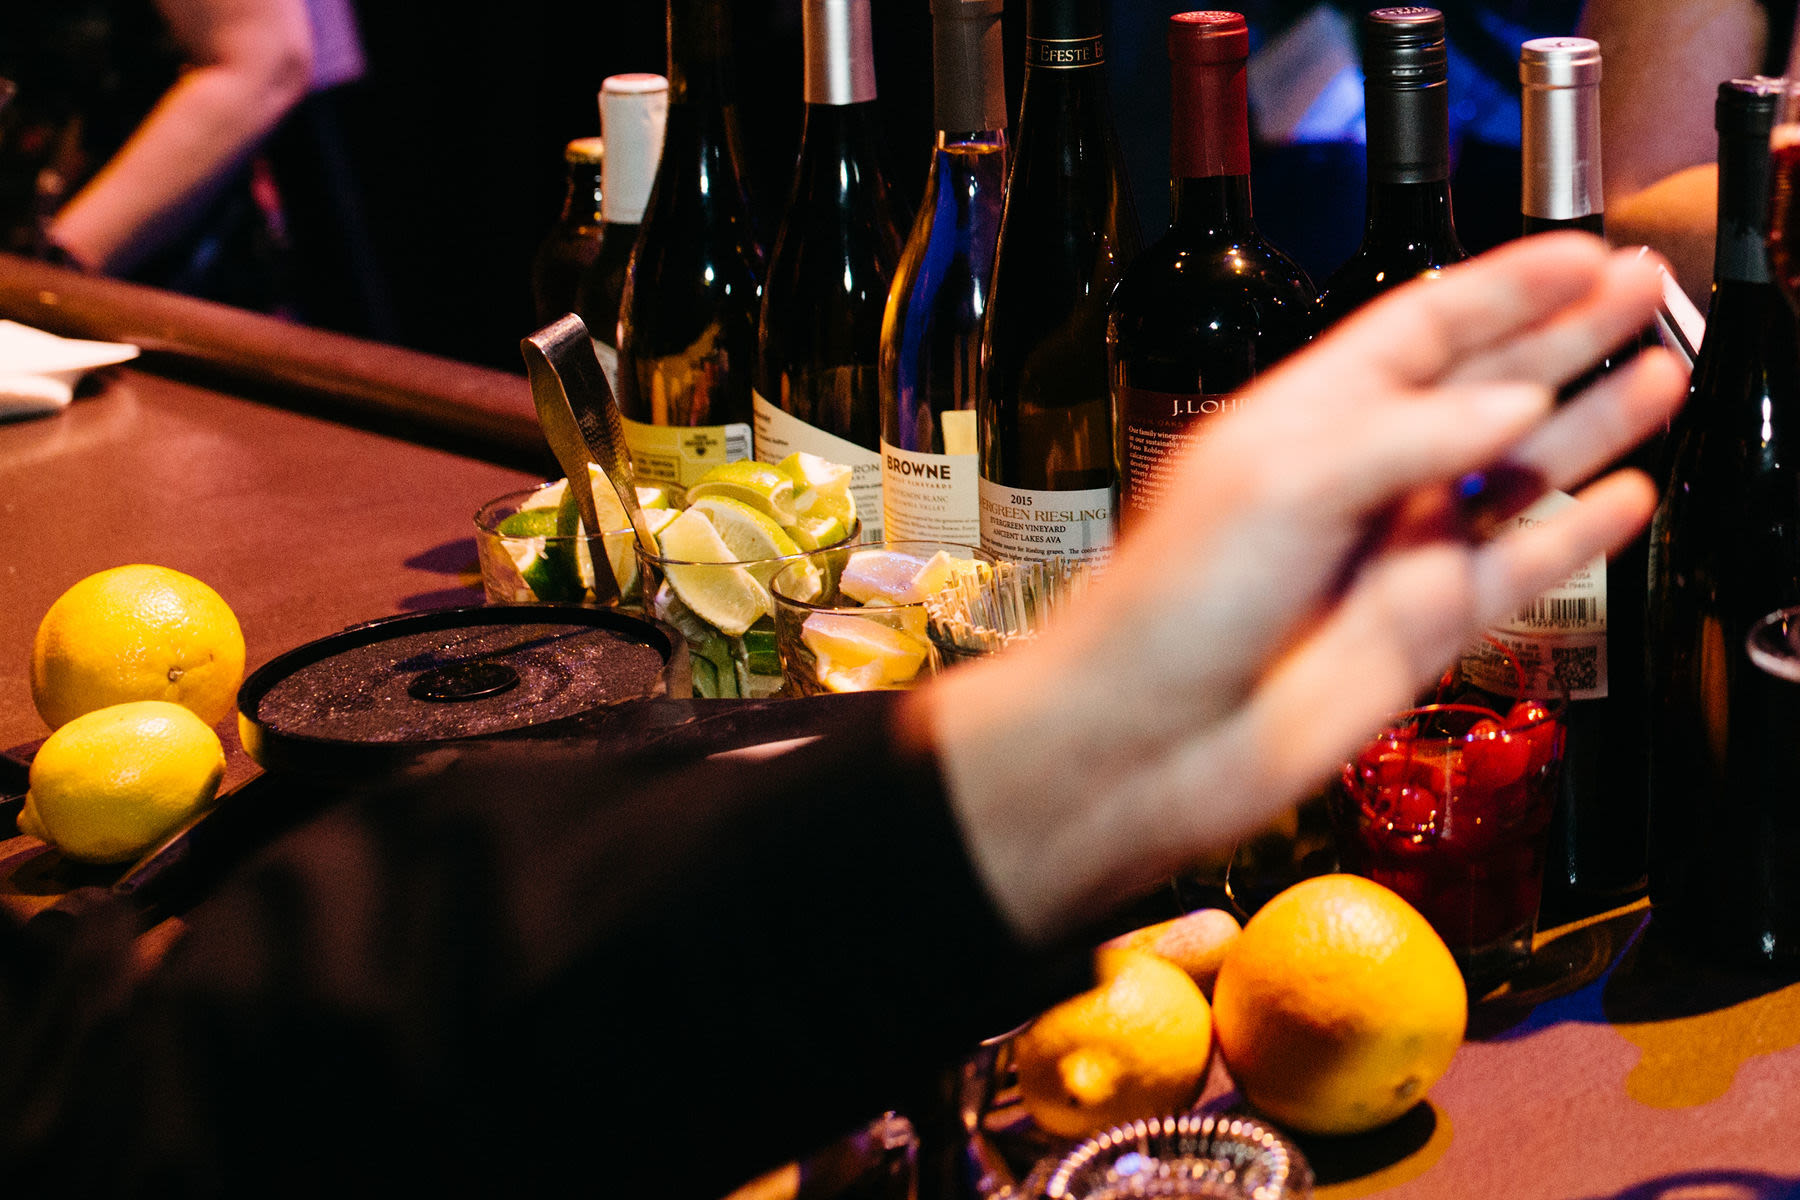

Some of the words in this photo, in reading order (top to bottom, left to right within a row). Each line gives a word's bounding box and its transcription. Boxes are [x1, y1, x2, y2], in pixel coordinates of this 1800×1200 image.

[887, 455, 952, 480] BROWNE
[1010, 494, 1033, 506] 2015
[981, 496, 1030, 521] ERGREEN
[1034, 508, 1106, 523] RIESLING
[993, 528, 1018, 541] ANCIENT
[1020, 534, 1044, 543] LAKES
[1024, 523, 1066, 533] VINEYARD
